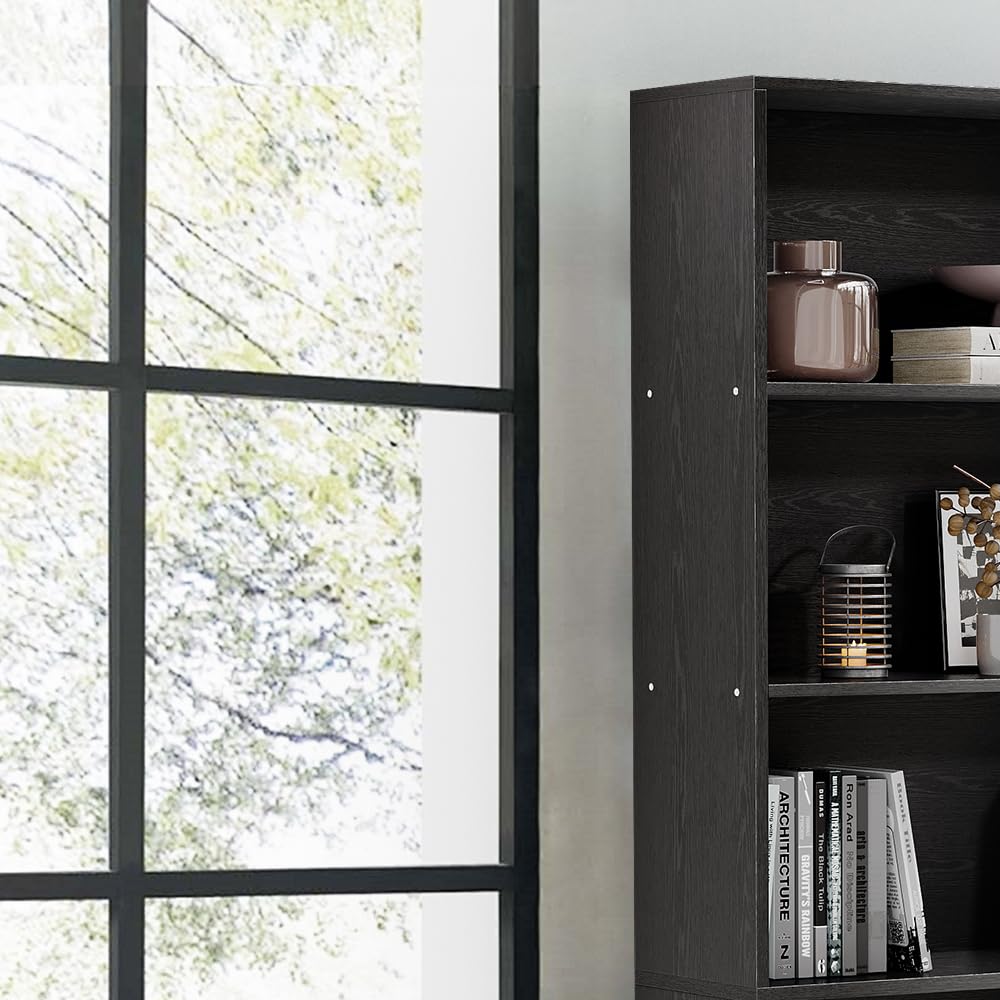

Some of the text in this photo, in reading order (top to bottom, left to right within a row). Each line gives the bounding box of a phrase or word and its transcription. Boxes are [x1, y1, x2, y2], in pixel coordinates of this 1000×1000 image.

[831, 807, 840, 854] MATHEMATICAL
[846, 783, 854, 842] Ron Arad
[857, 830, 867, 850] arts
[779, 791, 790, 921] ARCHITECTURE
[801, 854, 811, 958] GRAVITY'S RAINBOW
[817, 886, 825, 912] Tulip
[845, 851, 854, 932] No Discipline
[856, 865, 867, 924] architecture
